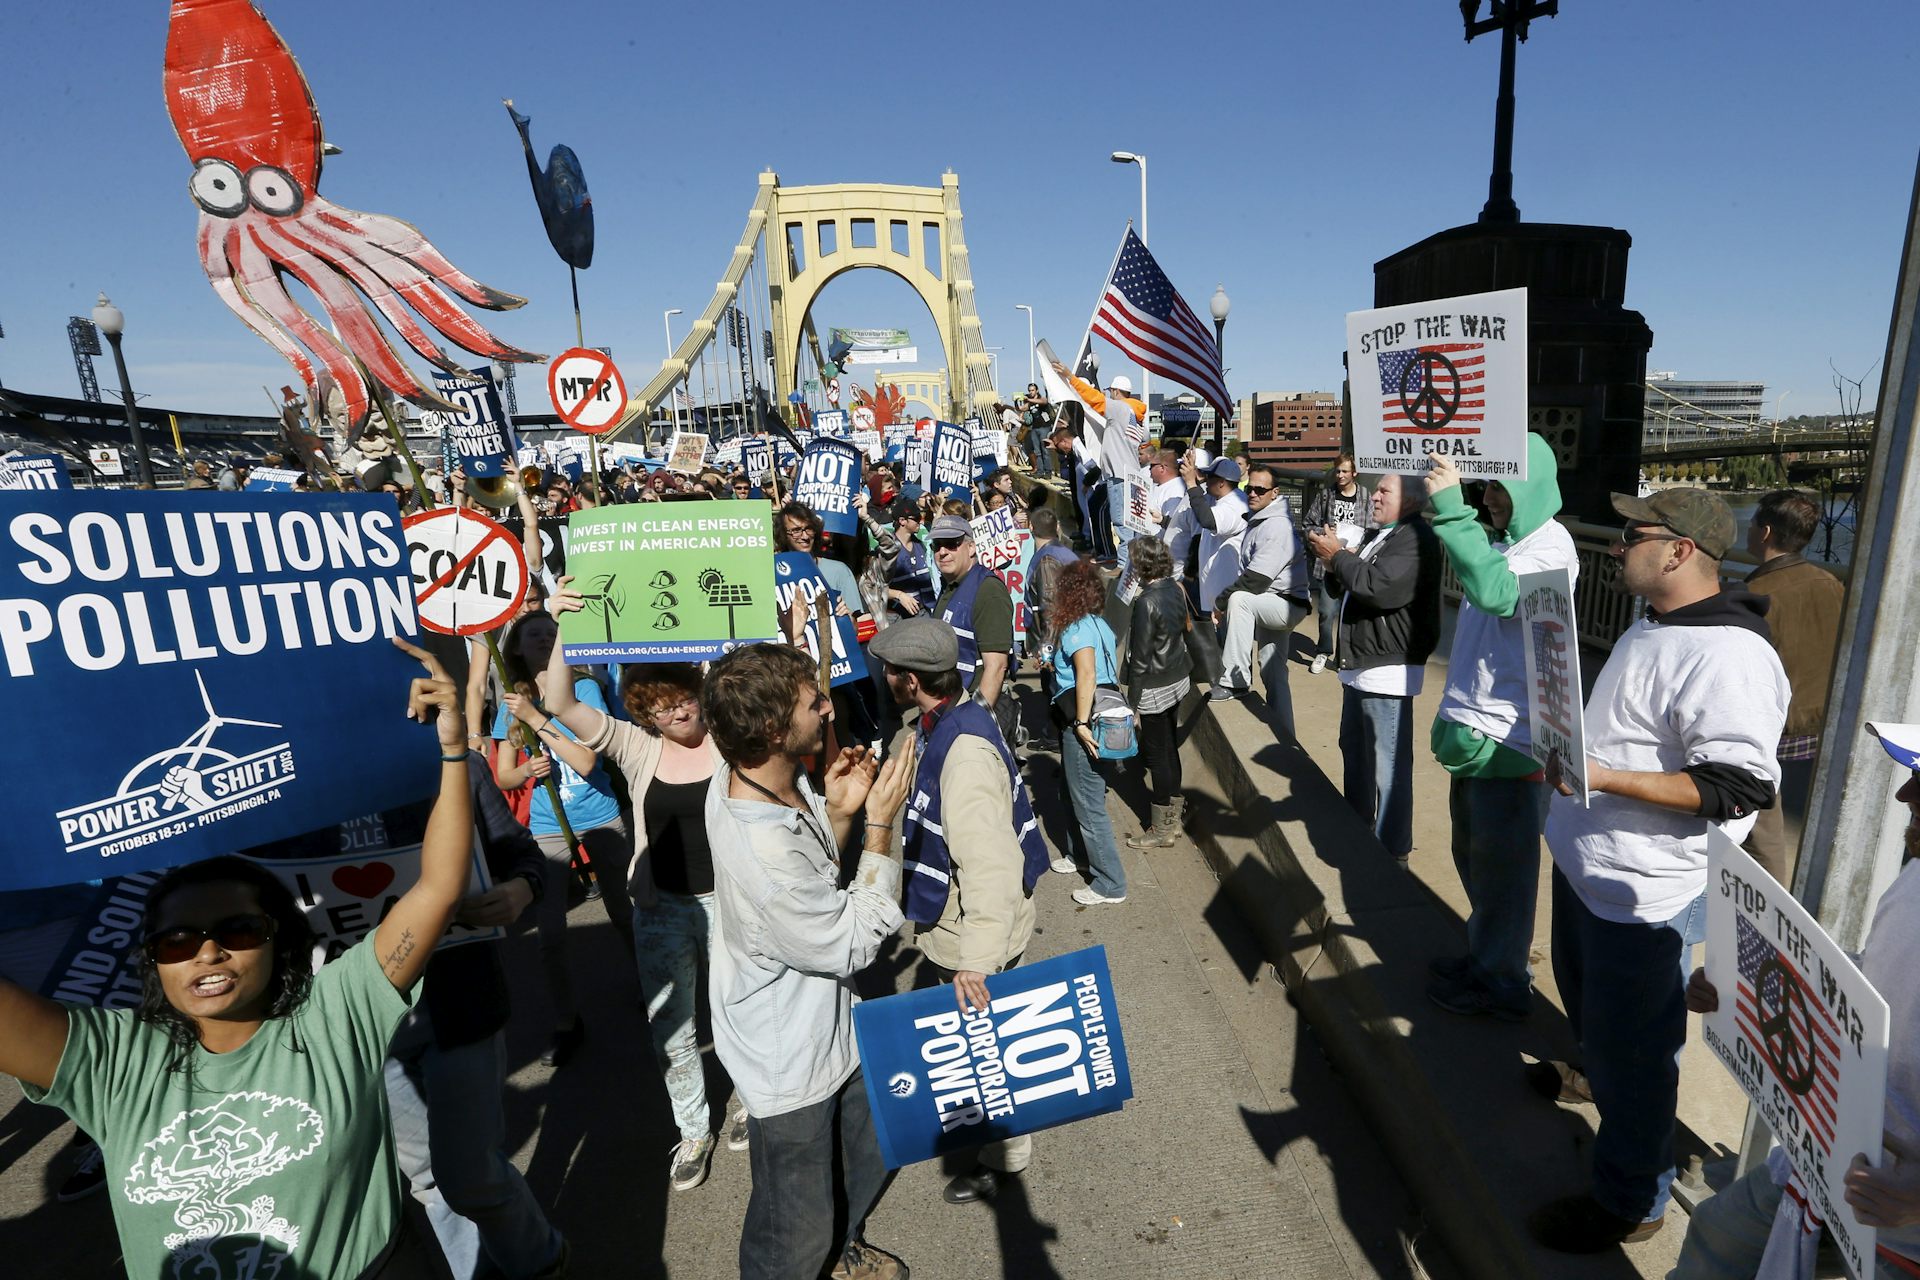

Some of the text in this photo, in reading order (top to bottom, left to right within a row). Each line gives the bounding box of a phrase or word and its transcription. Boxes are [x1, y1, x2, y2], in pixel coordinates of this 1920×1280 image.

[1361, 314, 1506, 354] STOP THE WAR
[560, 377, 612, 402] MTR
[818, 417, 843, 432] NOT
[941, 425, 960, 436] PEOPLE
[829, 443, 855, 459] POWER
[906, 447, 921, 465] NO
[937, 434, 971, 466] NOT
[1385, 438, 1482, 456] ON COAL
[25, 459, 54, 468] POWER
[799, 452, 855, 486] NOT
[935, 466, 970, 488] POWER
[936, 457, 970, 473] CORPORATE
[1359, 457, 1410, 470] BOILERMAKERS
[1455, 460, 1505, 475] PITTSBURGH
[1507, 462, 1519, 475] PA
[797, 482, 851, 497] CORPORATE
[573, 518, 764, 538] INVEST IN CLEAN ENERGY,
[973, 508, 1013, 538] THE DOE
[9, 509, 402, 585] SOLUTIONS
[569, 535, 768, 556] INVEST IN AMERICAN JOBS
[976, 541, 987, 553] IS
[987, 536, 1002, 549] FULL
[981, 539, 1018, 570] GAS
[407, 541, 512, 600] COAL
[1525, 586, 1569, 628] STOP THE WAR
[2, 575, 418, 678] POLLUTION
[565, 645, 718, 657] BEYONDCOAL.ORG/CLEAN-ENERGY
[1541, 724, 1551, 748] ON
[211, 755, 278, 797] SHIFT
[279, 750, 295, 774] 2013
[59, 796, 160, 844] POWER
[100, 788, 282, 858] OCTOBER 18-21 PITTSBURGH, PA
[1721, 868, 1864, 1059] STOP THE WAR
[990, 981, 1091, 1105] NOT
[1073, 973, 1117, 1091] PEOPLE POWER
[914, 1010, 985, 1133] POWER
[961, 1005, 1014, 1121] CORPORATE
[1736, 1036, 1764, 1087] ON
[1772, 1081, 1830, 1192] COAL
[1706, 1025, 1760, 1103] BOILERMAKERS
[1762, 1096, 1785, 1141] LOCAL
[1803, 1162, 1852, 1252] PITTSBURGH
[1852, 1246, 1863, 1279] PA
